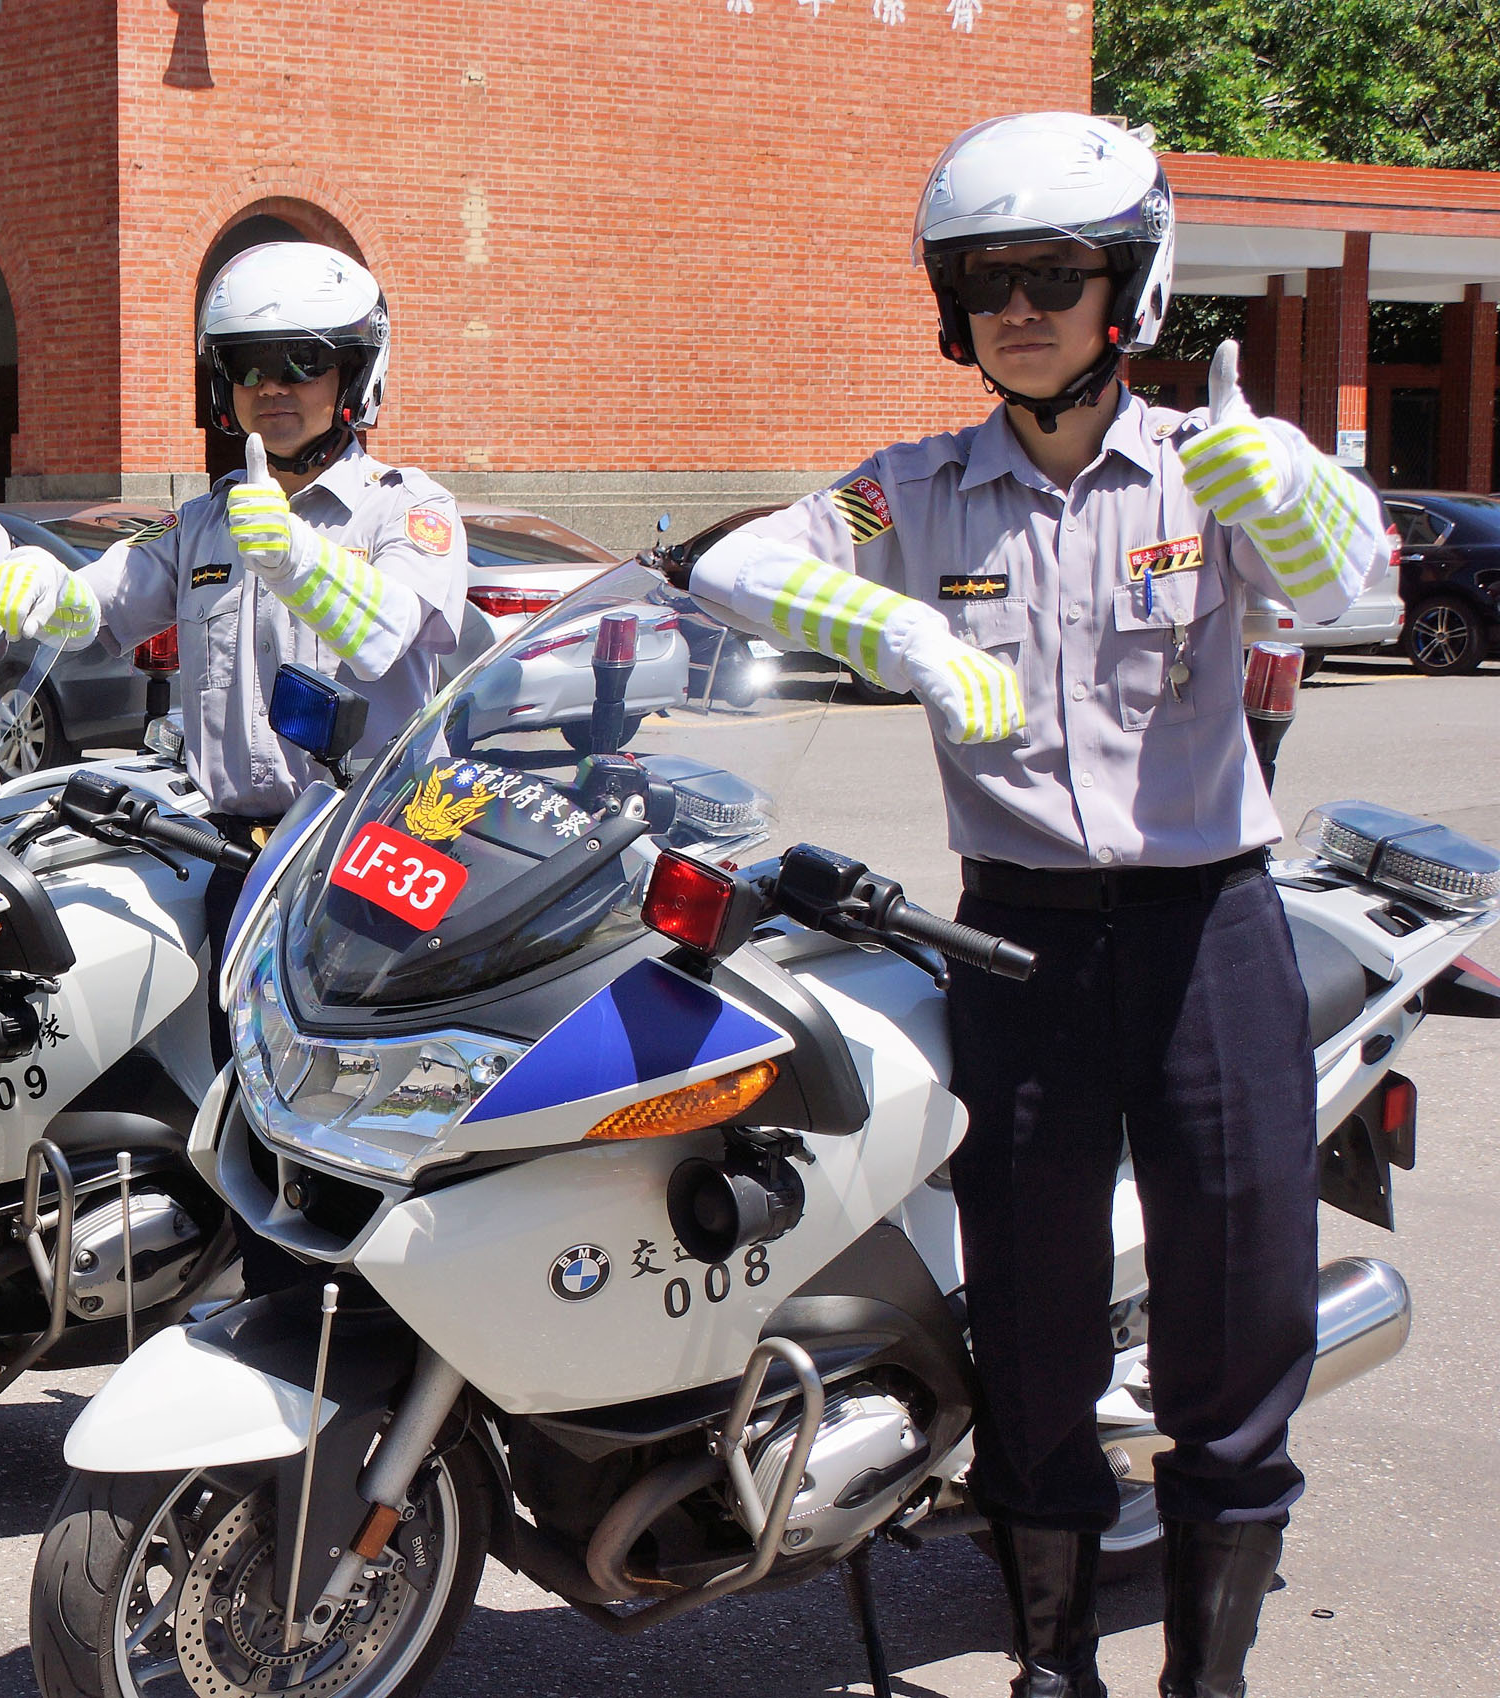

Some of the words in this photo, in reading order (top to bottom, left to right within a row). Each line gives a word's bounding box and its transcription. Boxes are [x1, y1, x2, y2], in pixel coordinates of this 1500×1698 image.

[342, 834, 447, 911] LF-33
[663, 1244, 770, 1319] 008
[411, 1535, 427, 1568] BMW
